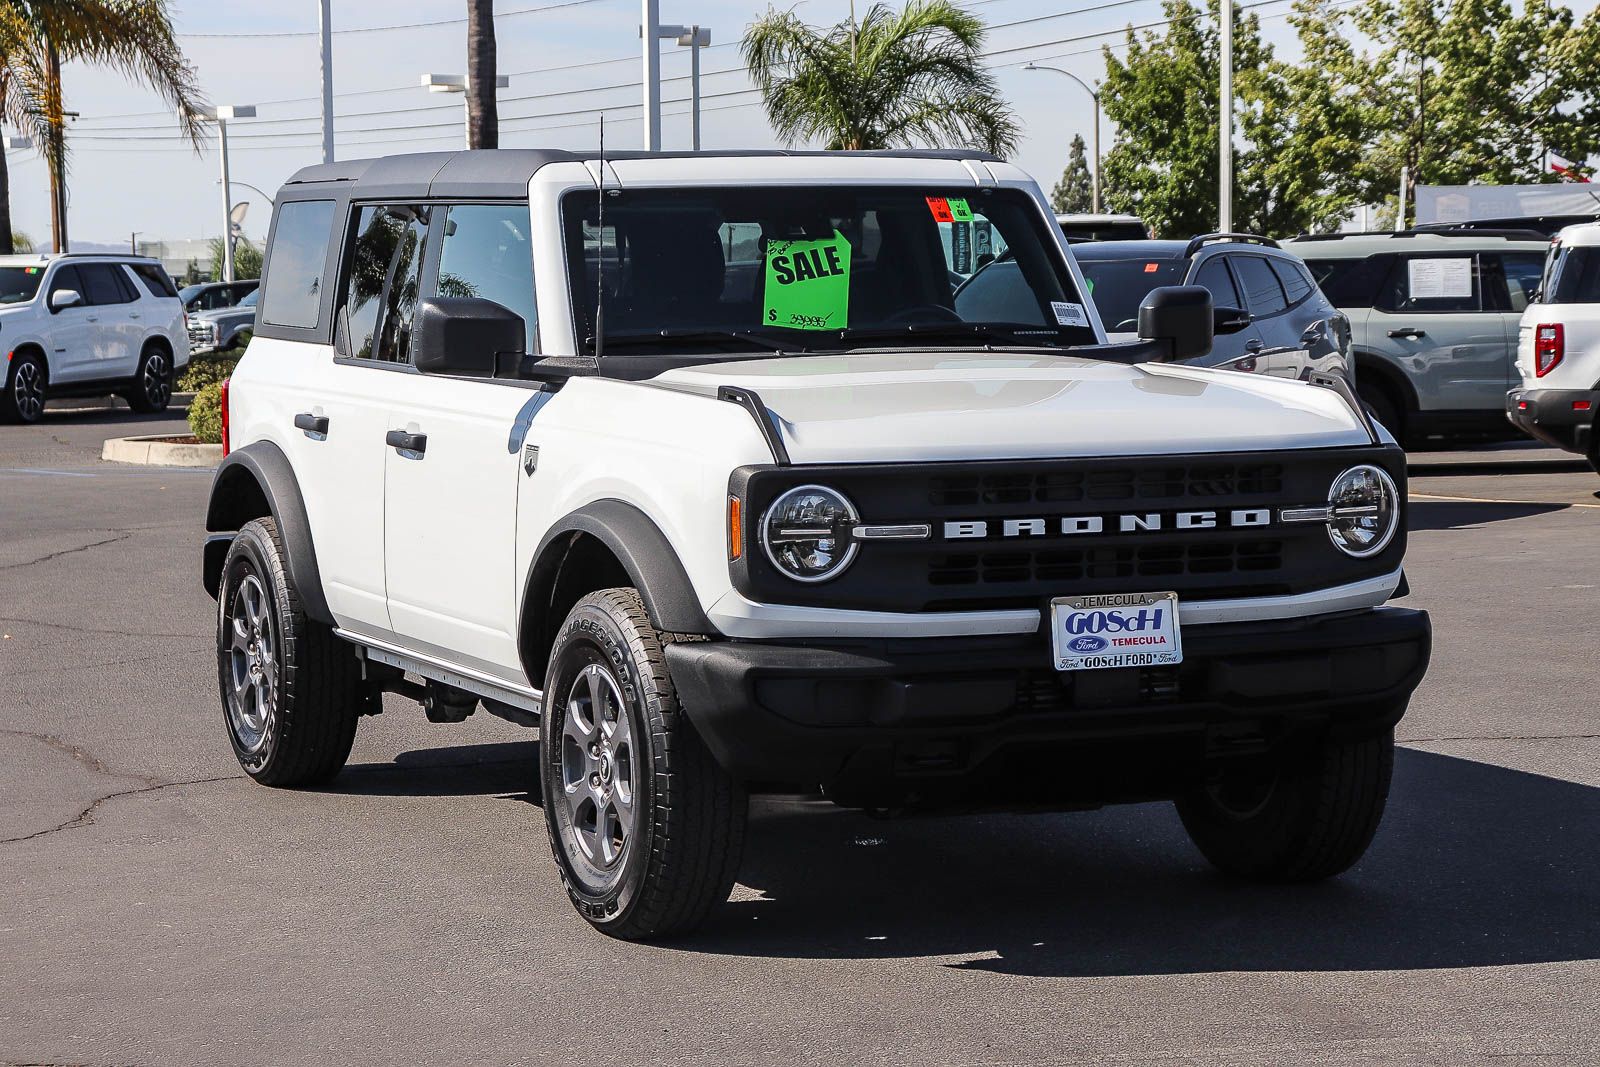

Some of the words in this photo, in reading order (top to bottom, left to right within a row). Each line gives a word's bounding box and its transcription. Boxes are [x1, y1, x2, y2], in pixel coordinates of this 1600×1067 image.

[772, 246, 844, 285] SALE
[769, 309, 777, 321] $
[944, 509, 1271, 538] BRONCO
[1081, 594, 1147, 607] TEMECULA
[1076, 639, 1099, 650] Ford
[1111, 636, 1167, 647] TEMECULA
[1060, 658, 1079, 669] Ford
[1125, 653, 1153, 665] FORD
[1159, 653, 1178, 663] Ford
